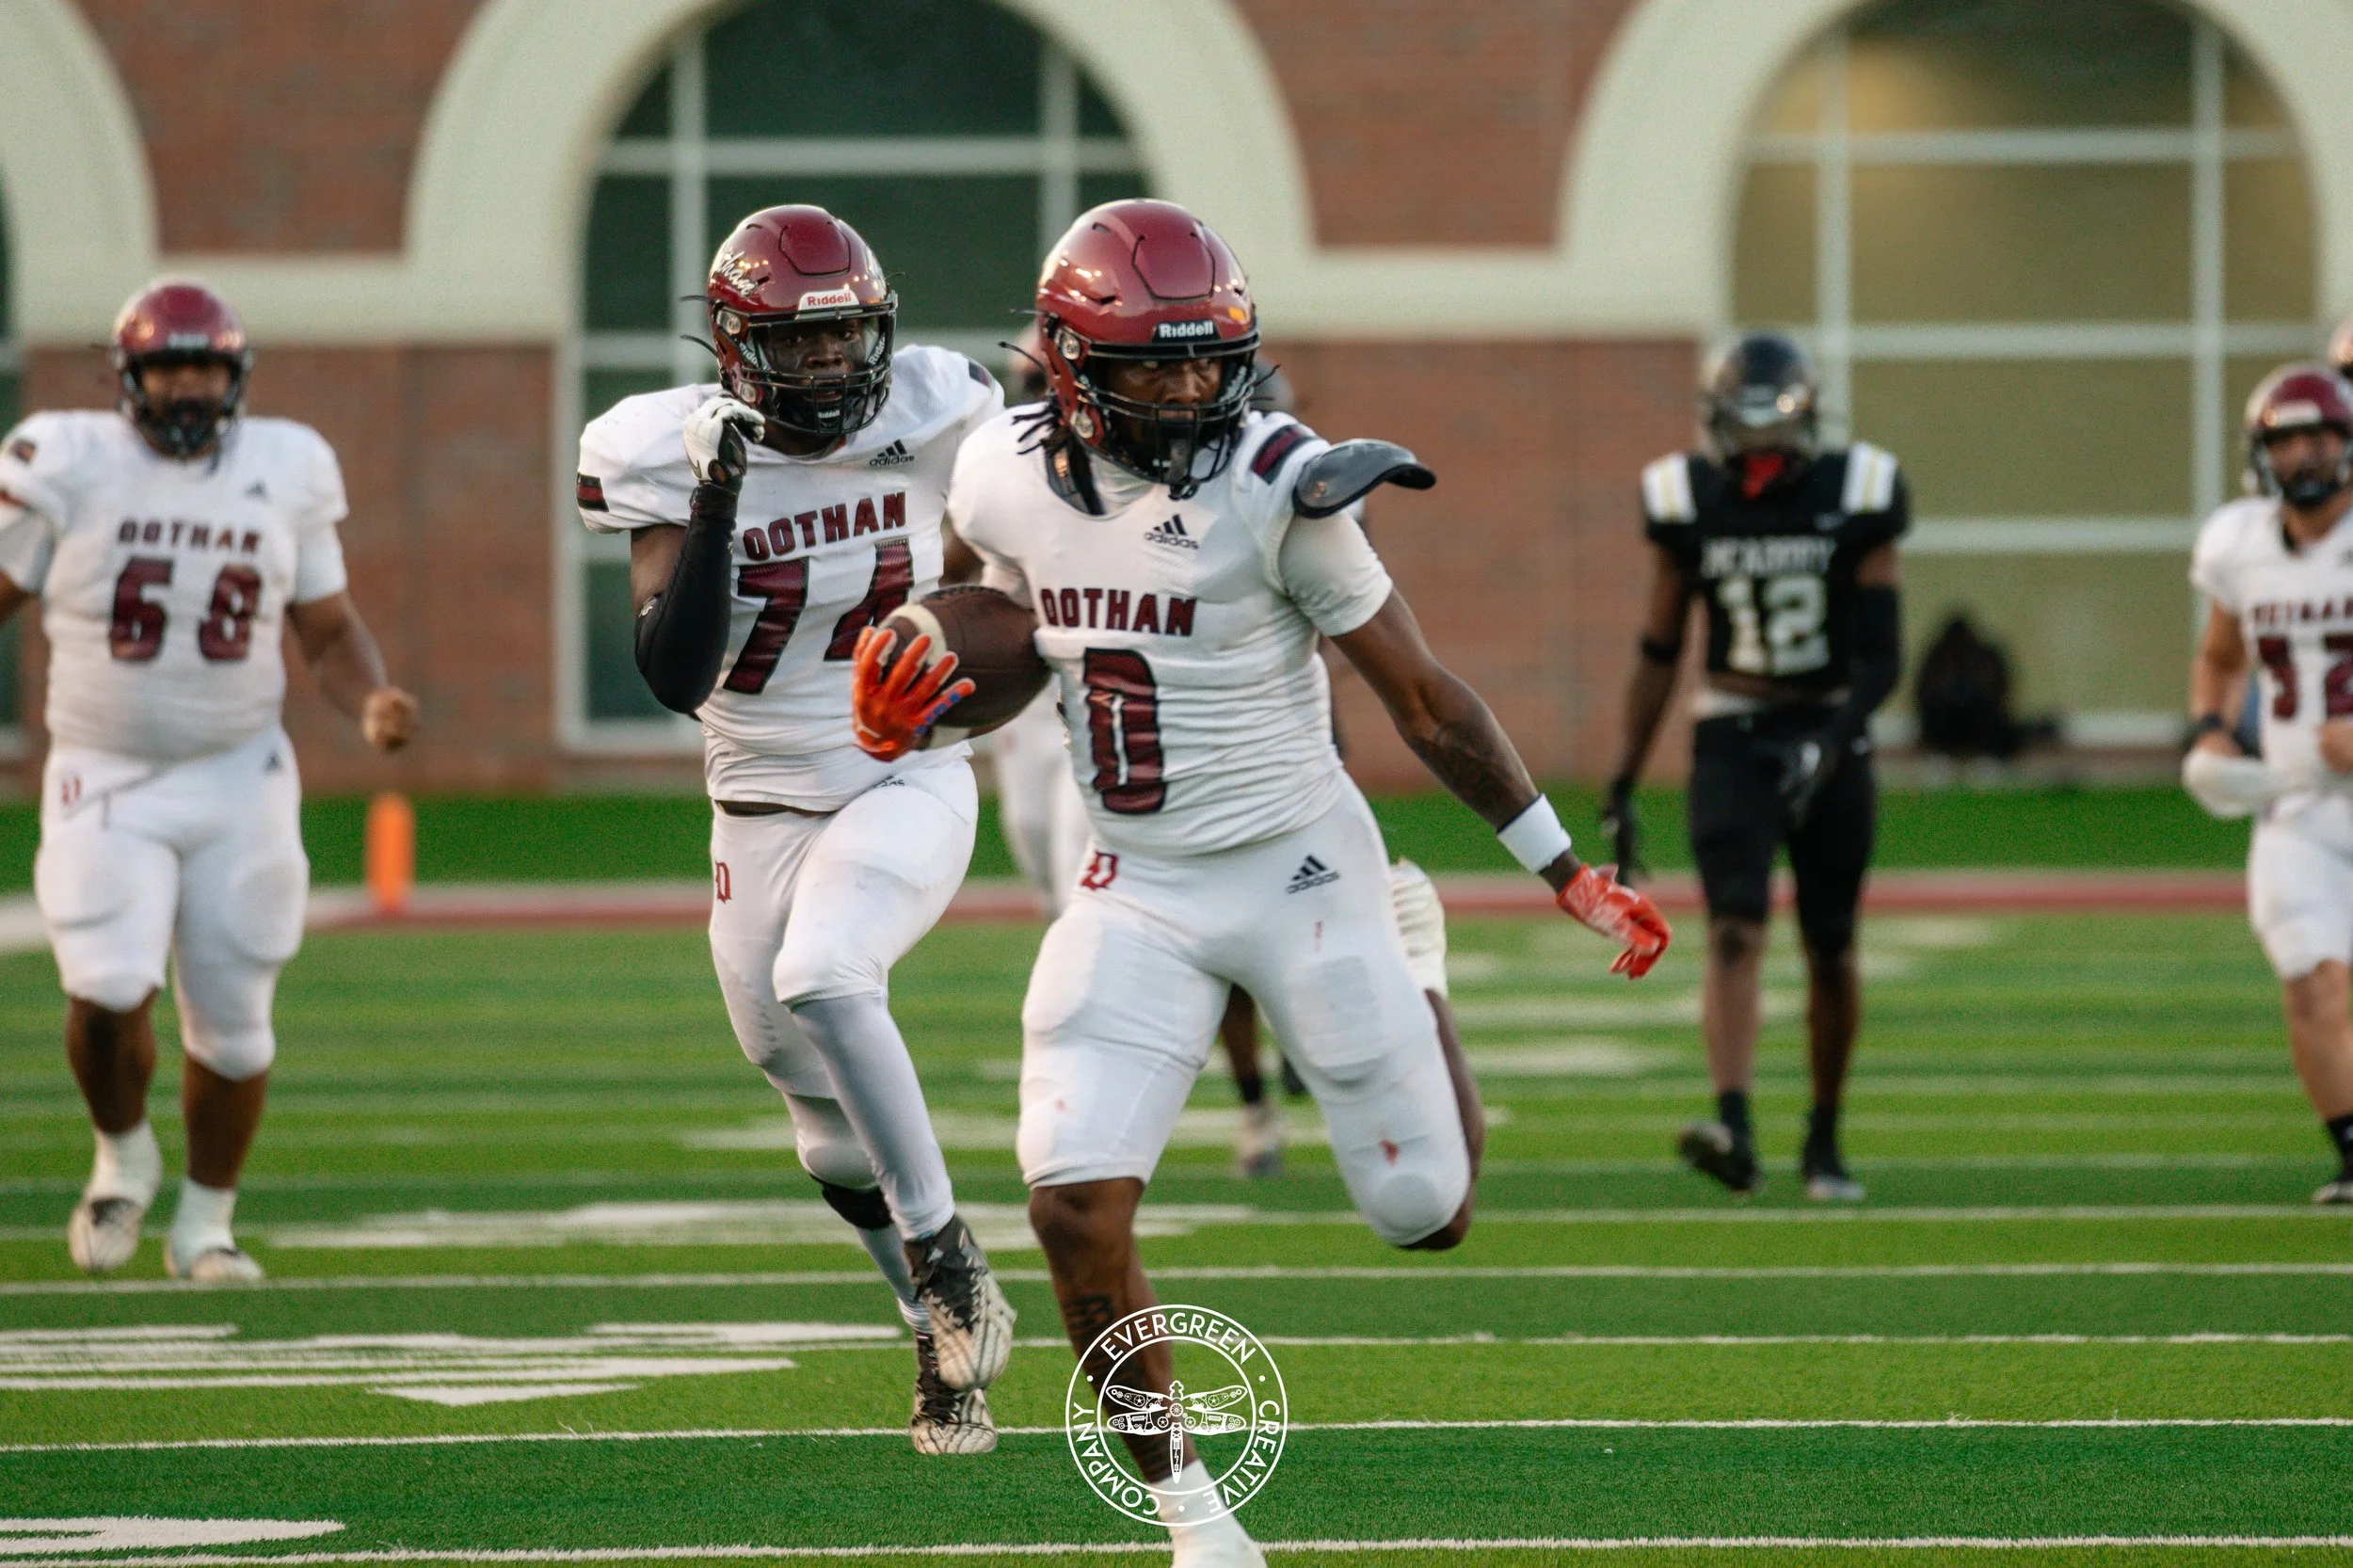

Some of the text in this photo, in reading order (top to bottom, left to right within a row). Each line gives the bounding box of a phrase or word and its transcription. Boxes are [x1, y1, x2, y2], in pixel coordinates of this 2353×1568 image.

[807, 293, 852, 307] Riddell
[1159, 320, 1213, 339] Riddell
[869, 454, 915, 467] adidas
[119, 520, 261, 553] DOTHAN
[744, 491, 906, 562] DOTHAN
[1144, 530, 1199, 551] adidas
[723, 537, 914, 695] 74
[1041, 587, 1197, 637] DOTHAN
[1717, 574, 1831, 675] 12
[1083, 647, 1167, 816] 0
[1080, 851, 1118, 890] D
